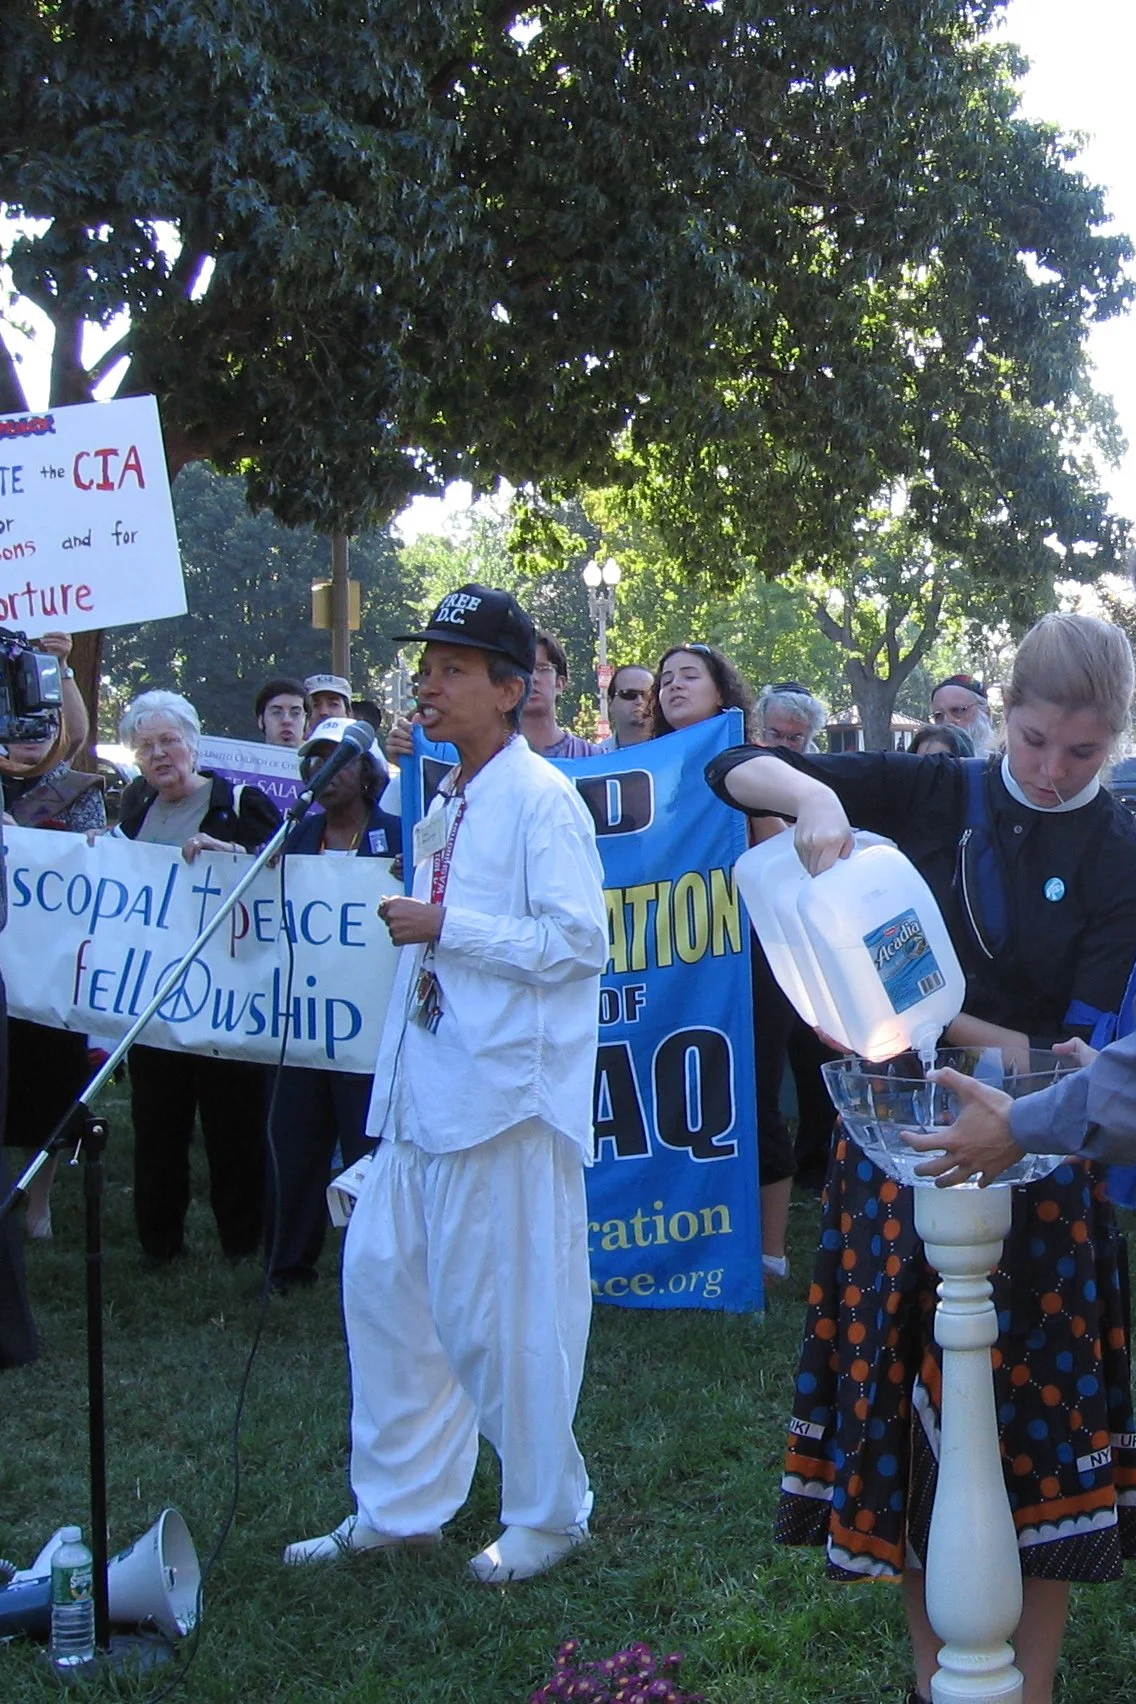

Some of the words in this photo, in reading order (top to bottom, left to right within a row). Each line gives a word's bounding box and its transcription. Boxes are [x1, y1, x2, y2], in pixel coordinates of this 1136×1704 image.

[40, 464, 65, 479] the
[73, 445, 146, 492] CIA
[0, 541, 36, 560] ons
[62, 529, 92, 549] and
[111, 520, 138, 546] for
[440, 592, 482, 611] FREE
[874, 920, 921, 967] Acadia
[598, 982, 647, 1027] OF
[593, 1025, 739, 1164] AQ
